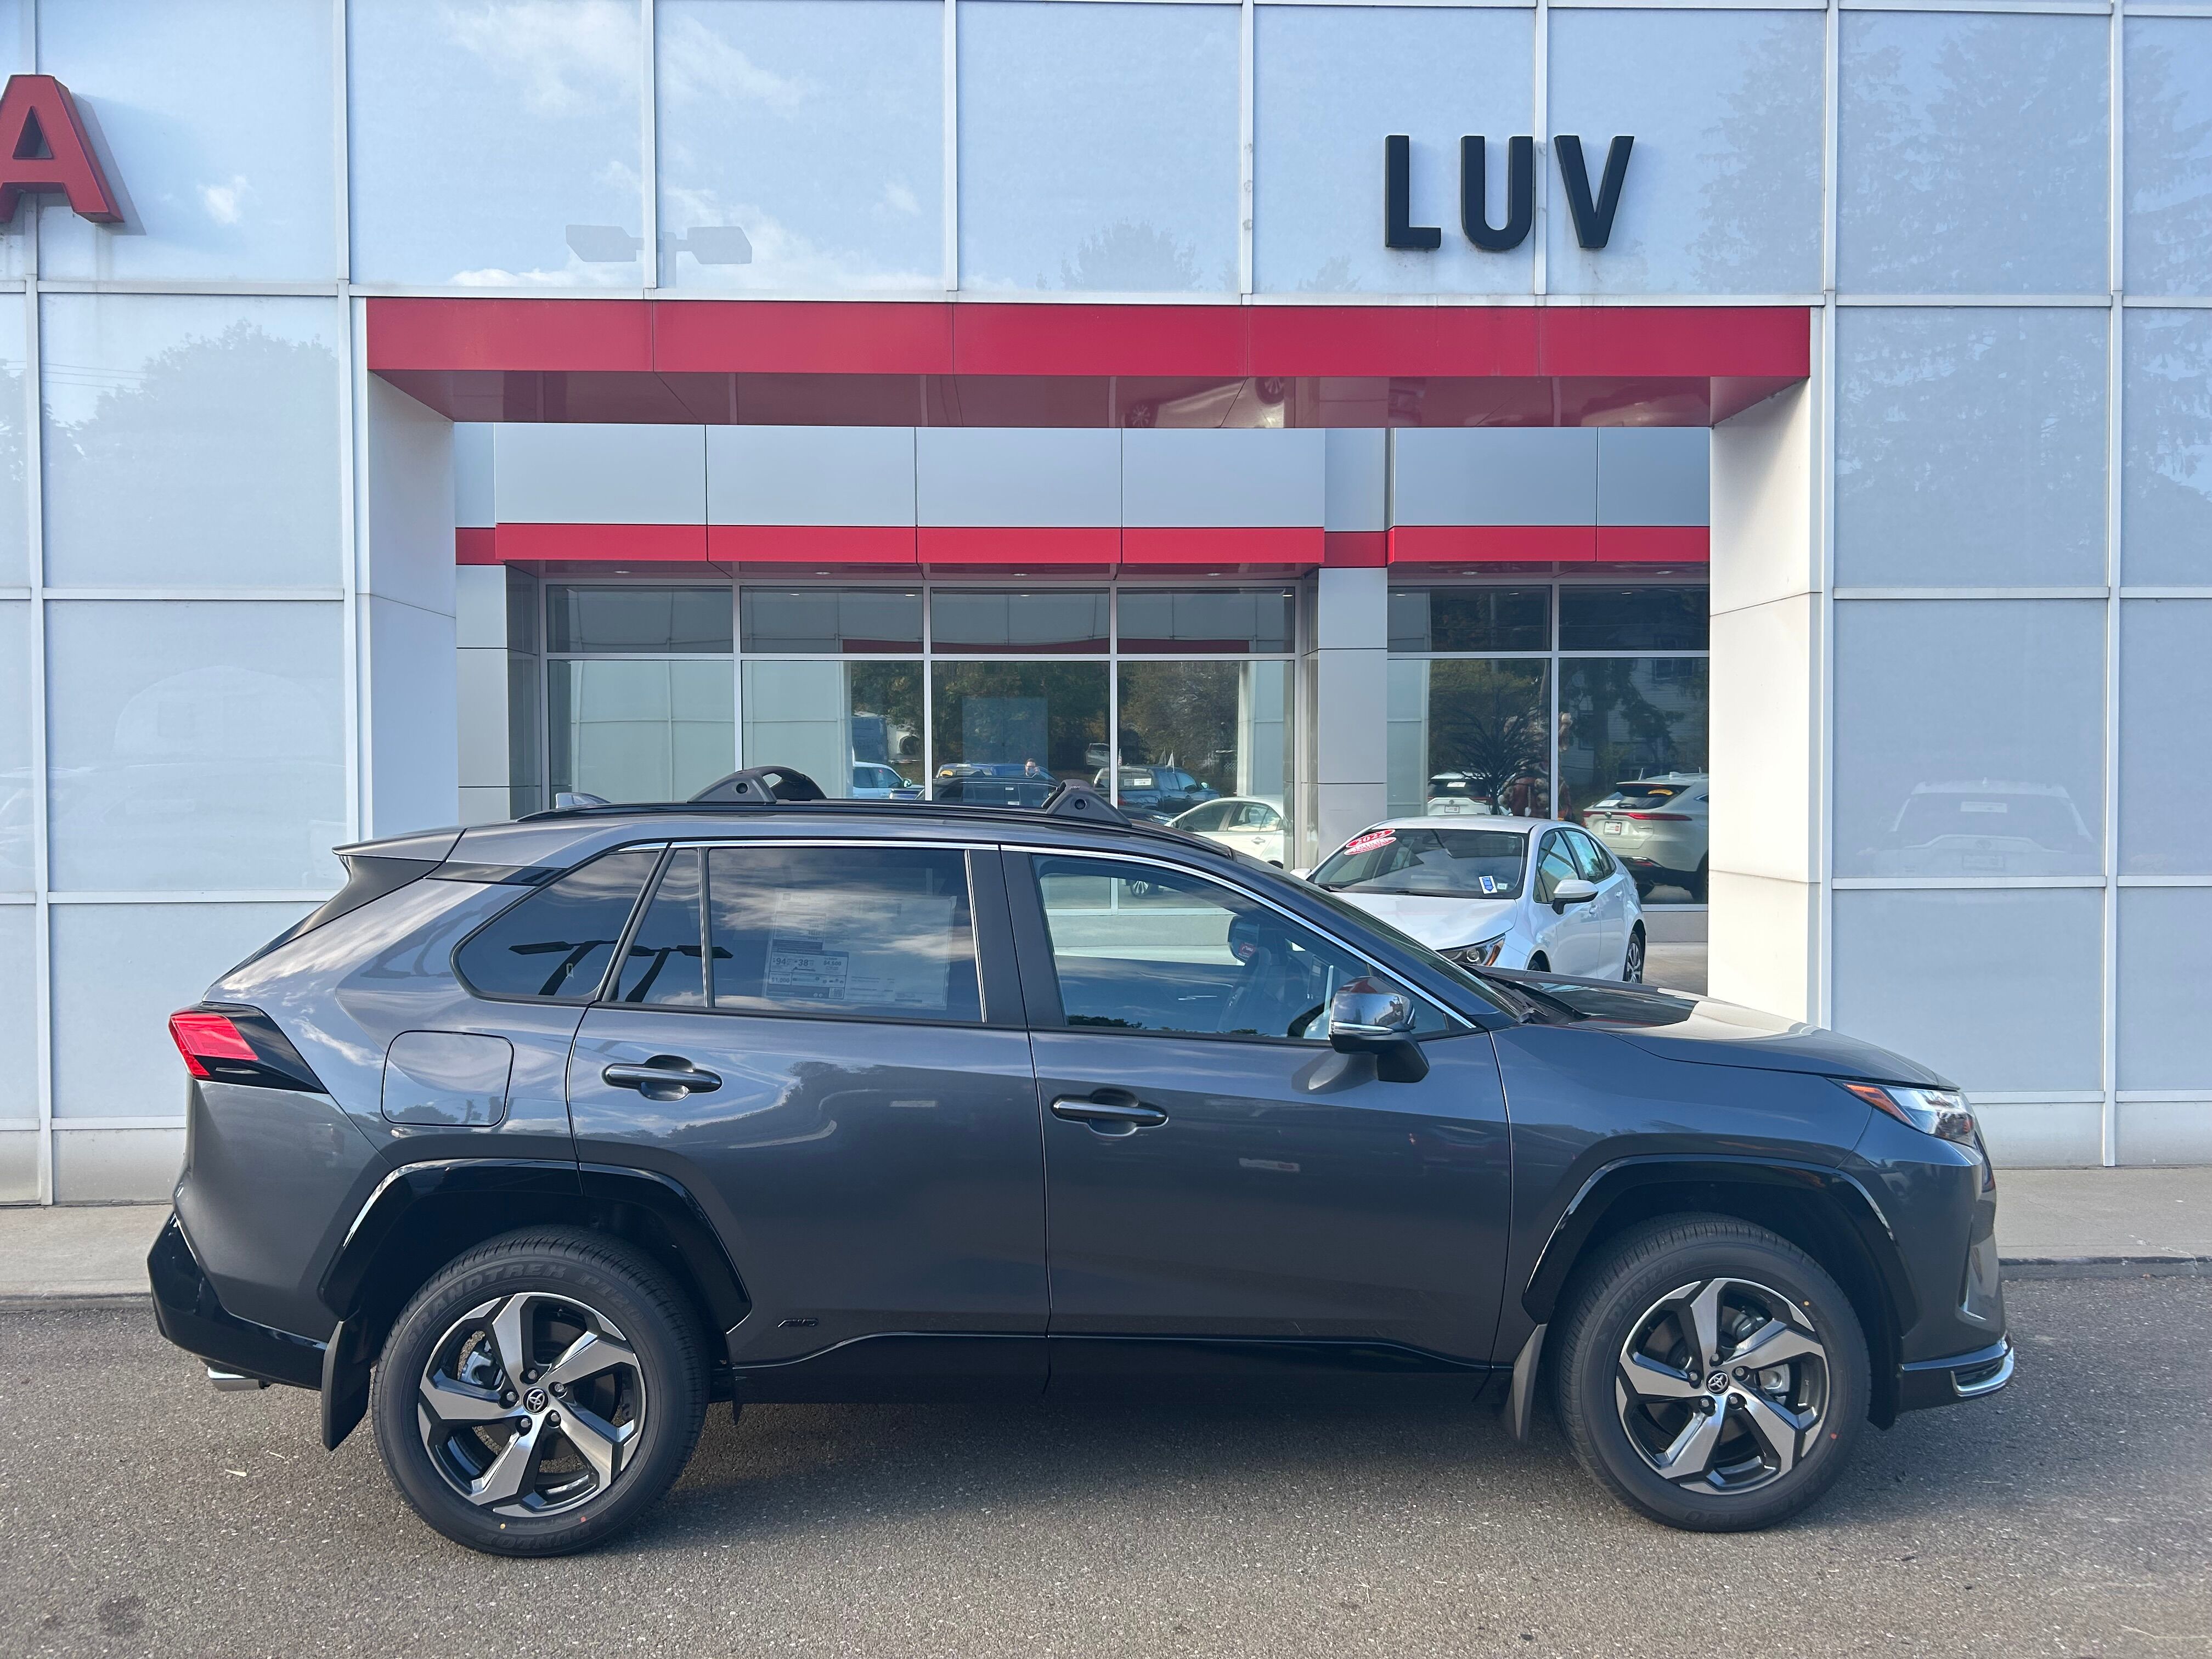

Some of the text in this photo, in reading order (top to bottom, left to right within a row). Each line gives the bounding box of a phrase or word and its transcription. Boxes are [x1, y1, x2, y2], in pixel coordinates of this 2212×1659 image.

[0, 74, 124, 223] A
[1385, 135, 1635, 250] LUV
[1355, 832, 1385, 845] 2022
[404, 1263, 645, 1353] GRANDTREK PT20
[476, 1522, 592, 1550] DUNLOP
